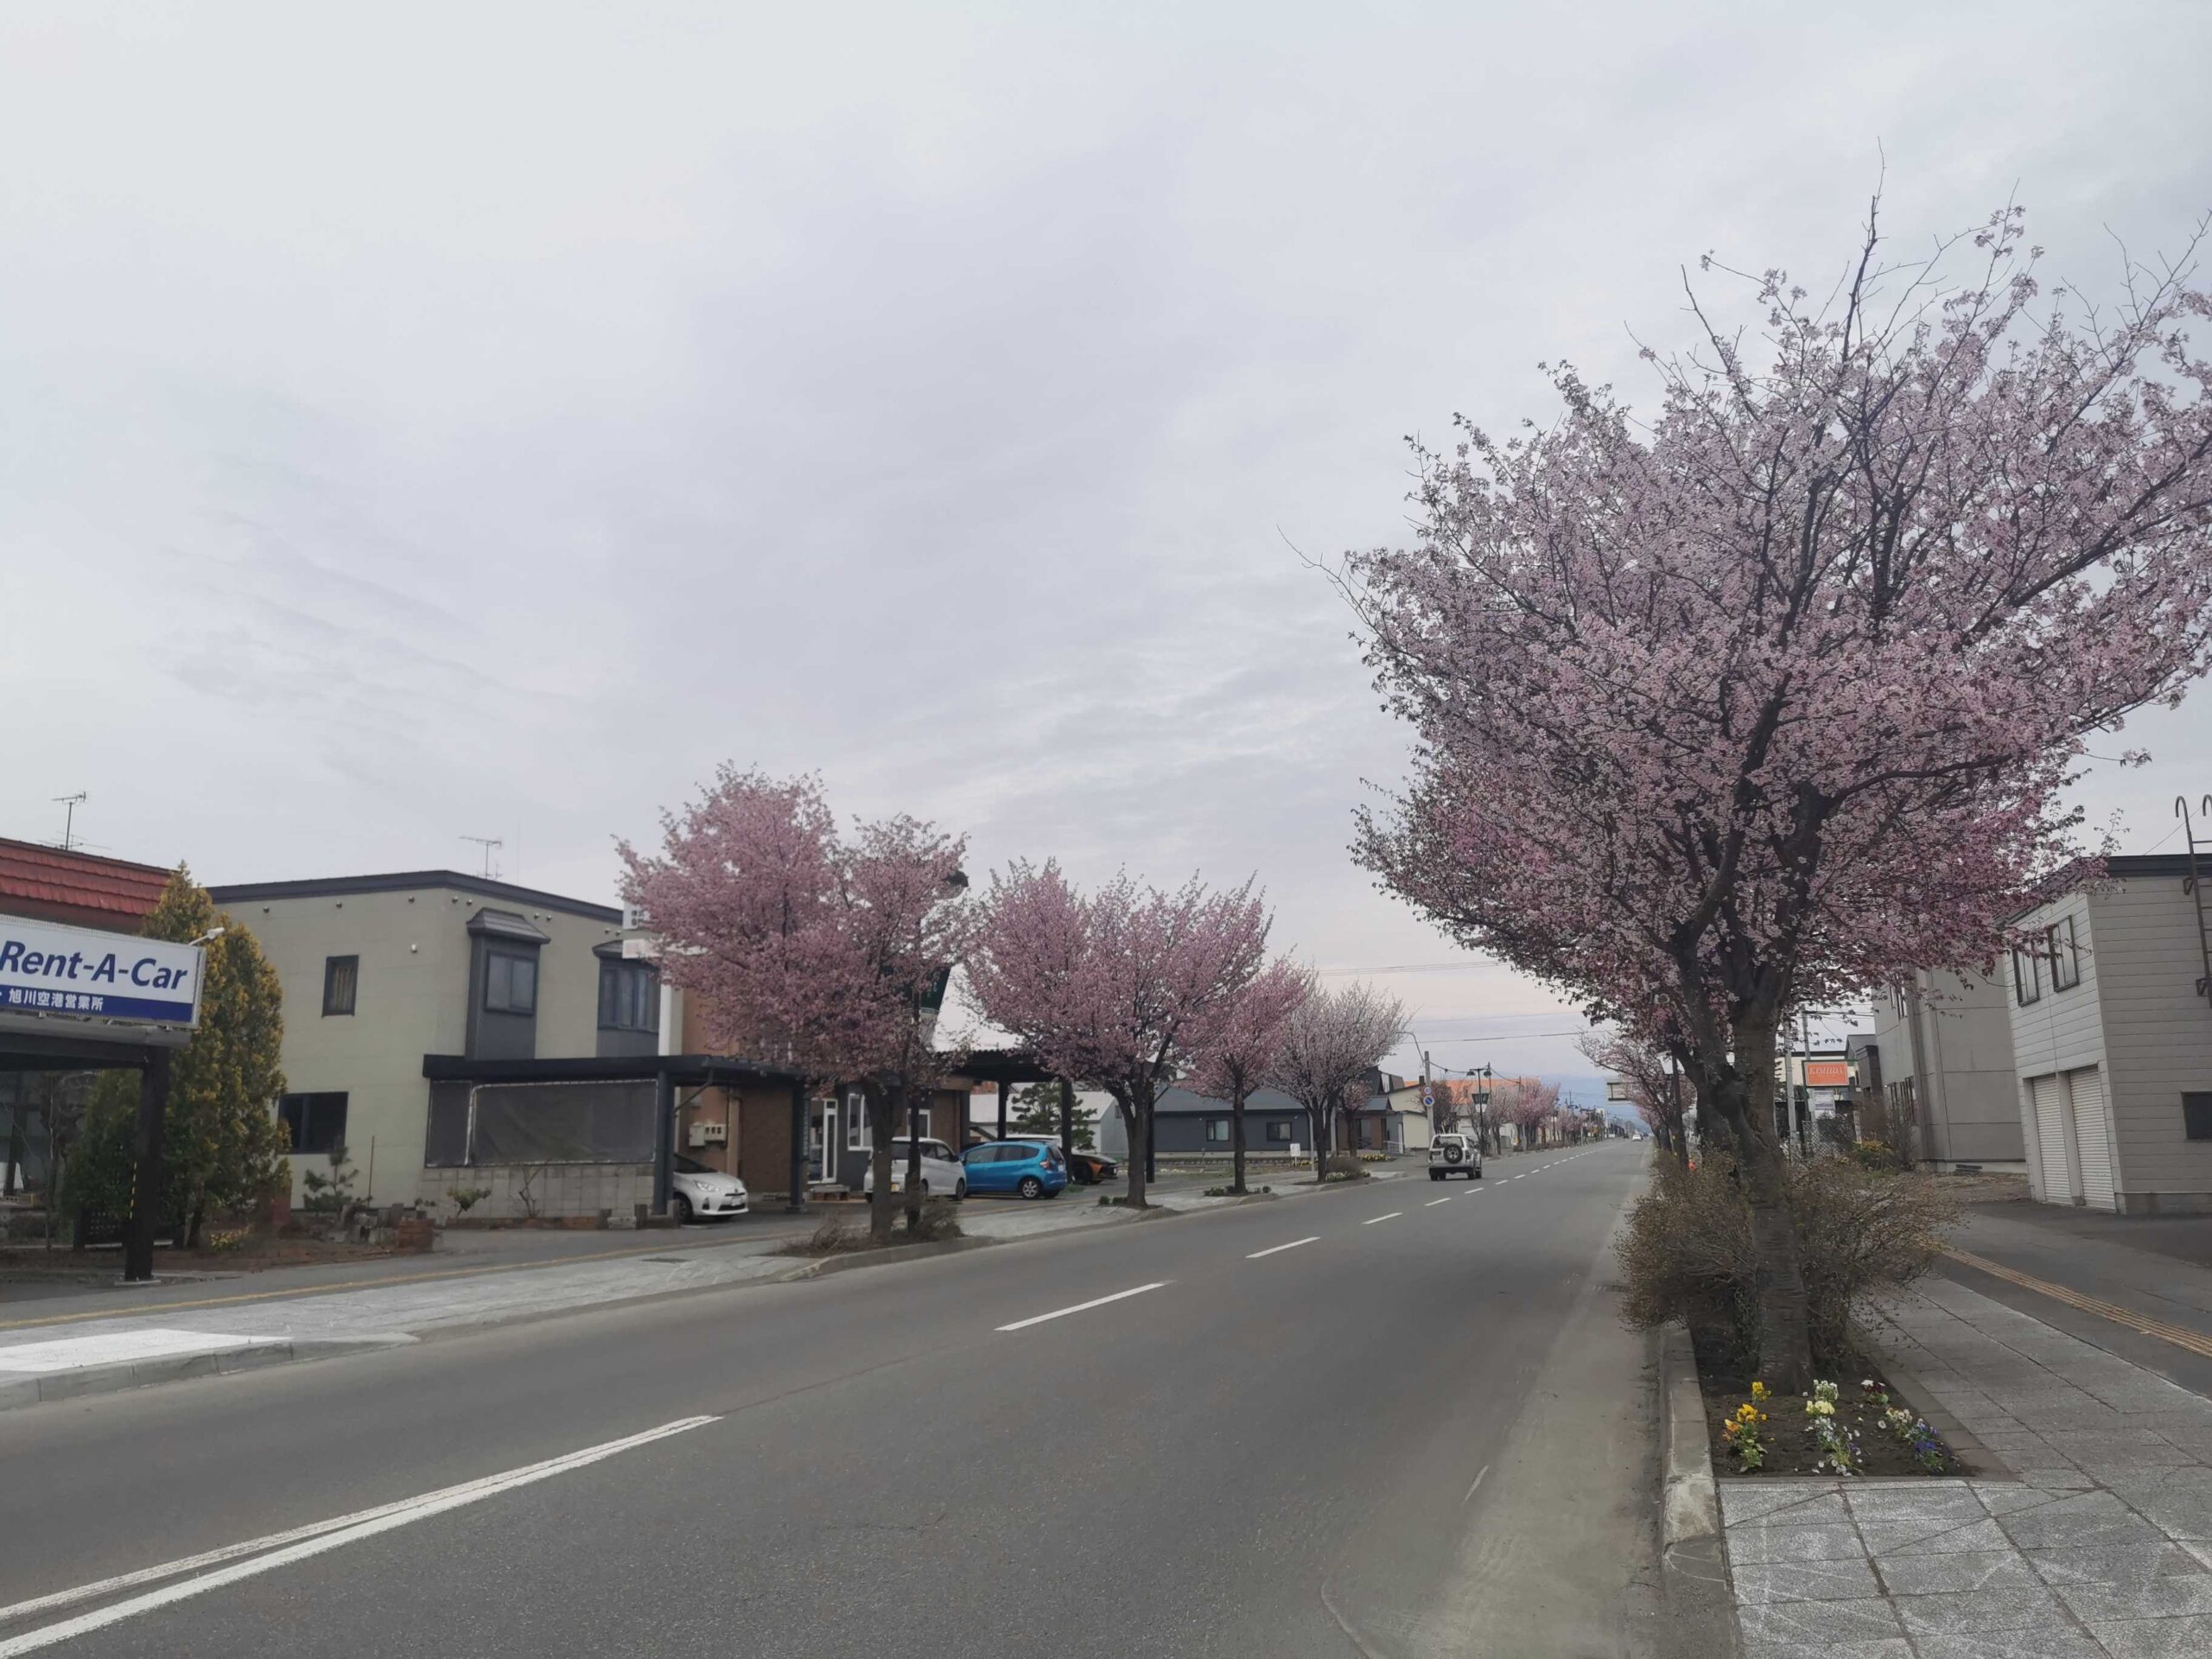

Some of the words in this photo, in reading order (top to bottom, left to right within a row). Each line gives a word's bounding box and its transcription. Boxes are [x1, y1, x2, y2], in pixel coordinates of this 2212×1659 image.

[0, 940, 188, 989] Rent-A-Car
[9, 988, 104, 1011] 旭川空港営業所
